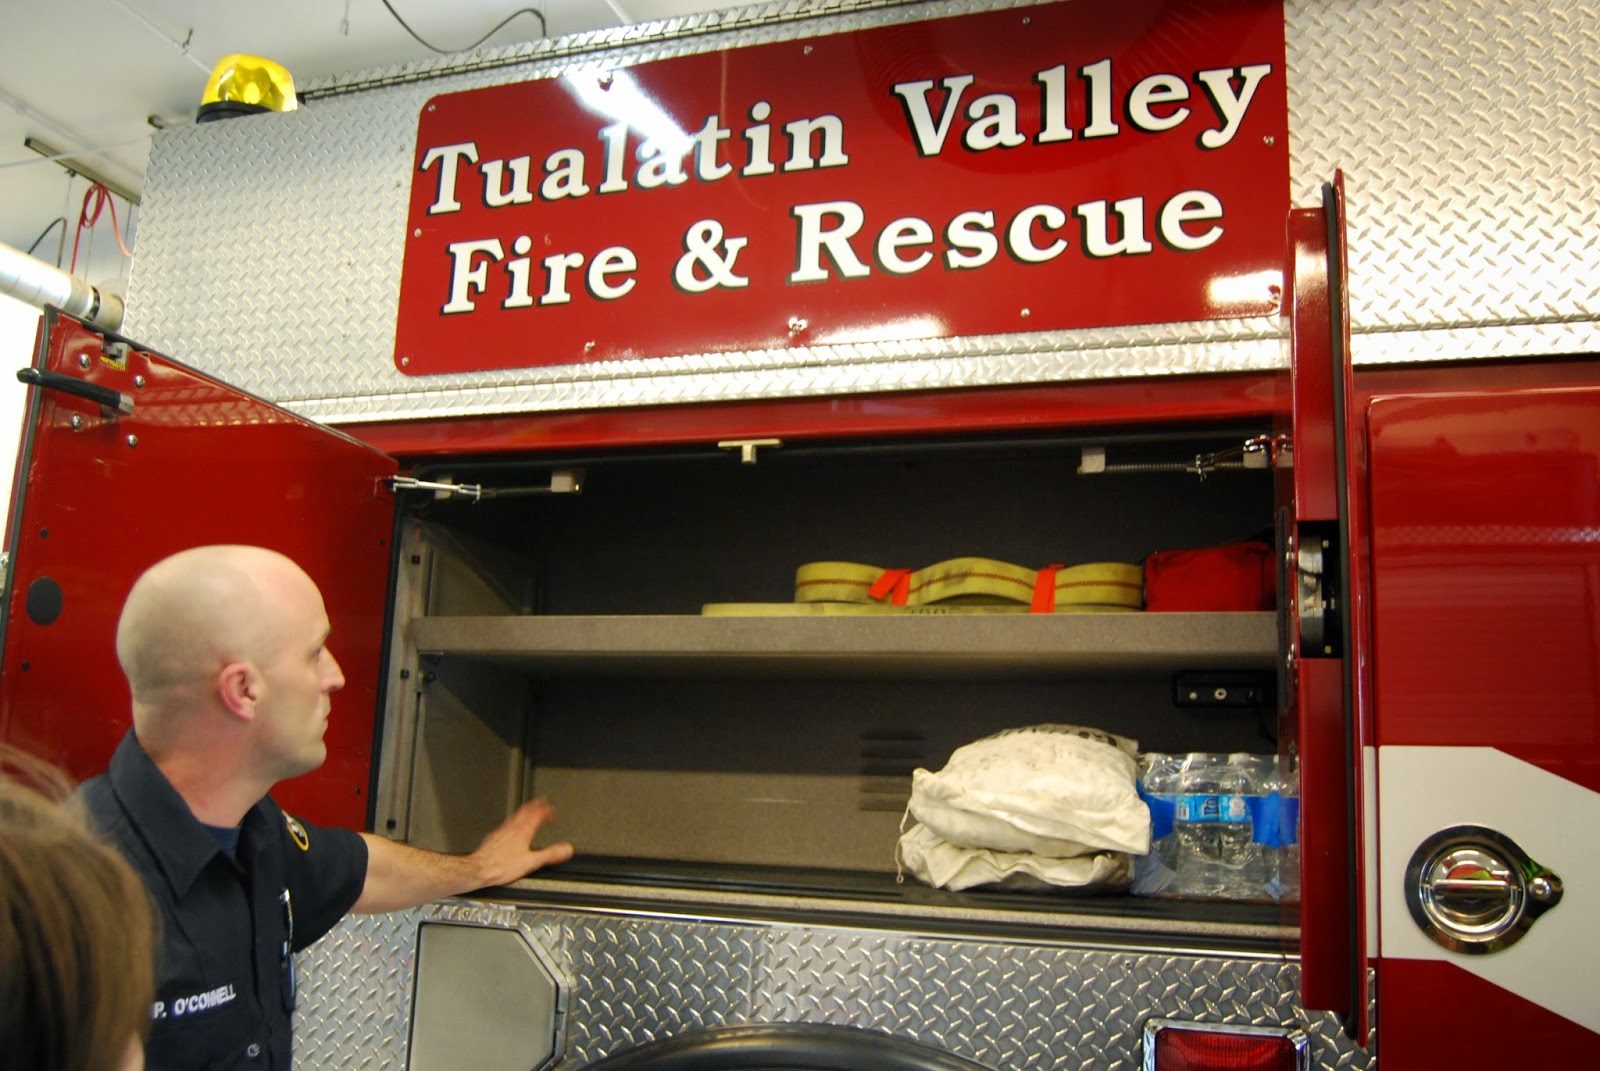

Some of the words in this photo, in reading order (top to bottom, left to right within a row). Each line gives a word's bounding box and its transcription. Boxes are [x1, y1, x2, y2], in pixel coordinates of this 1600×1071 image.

[420, 100, 849, 216] Tualatin
[891, 58, 1271, 158] Valley
[440, 234, 638, 315] Fire
[673, 218, 749, 293] &
[787, 189, 1225, 285] Rescue
[174, 983, 236, 1015] O'CONNELL
